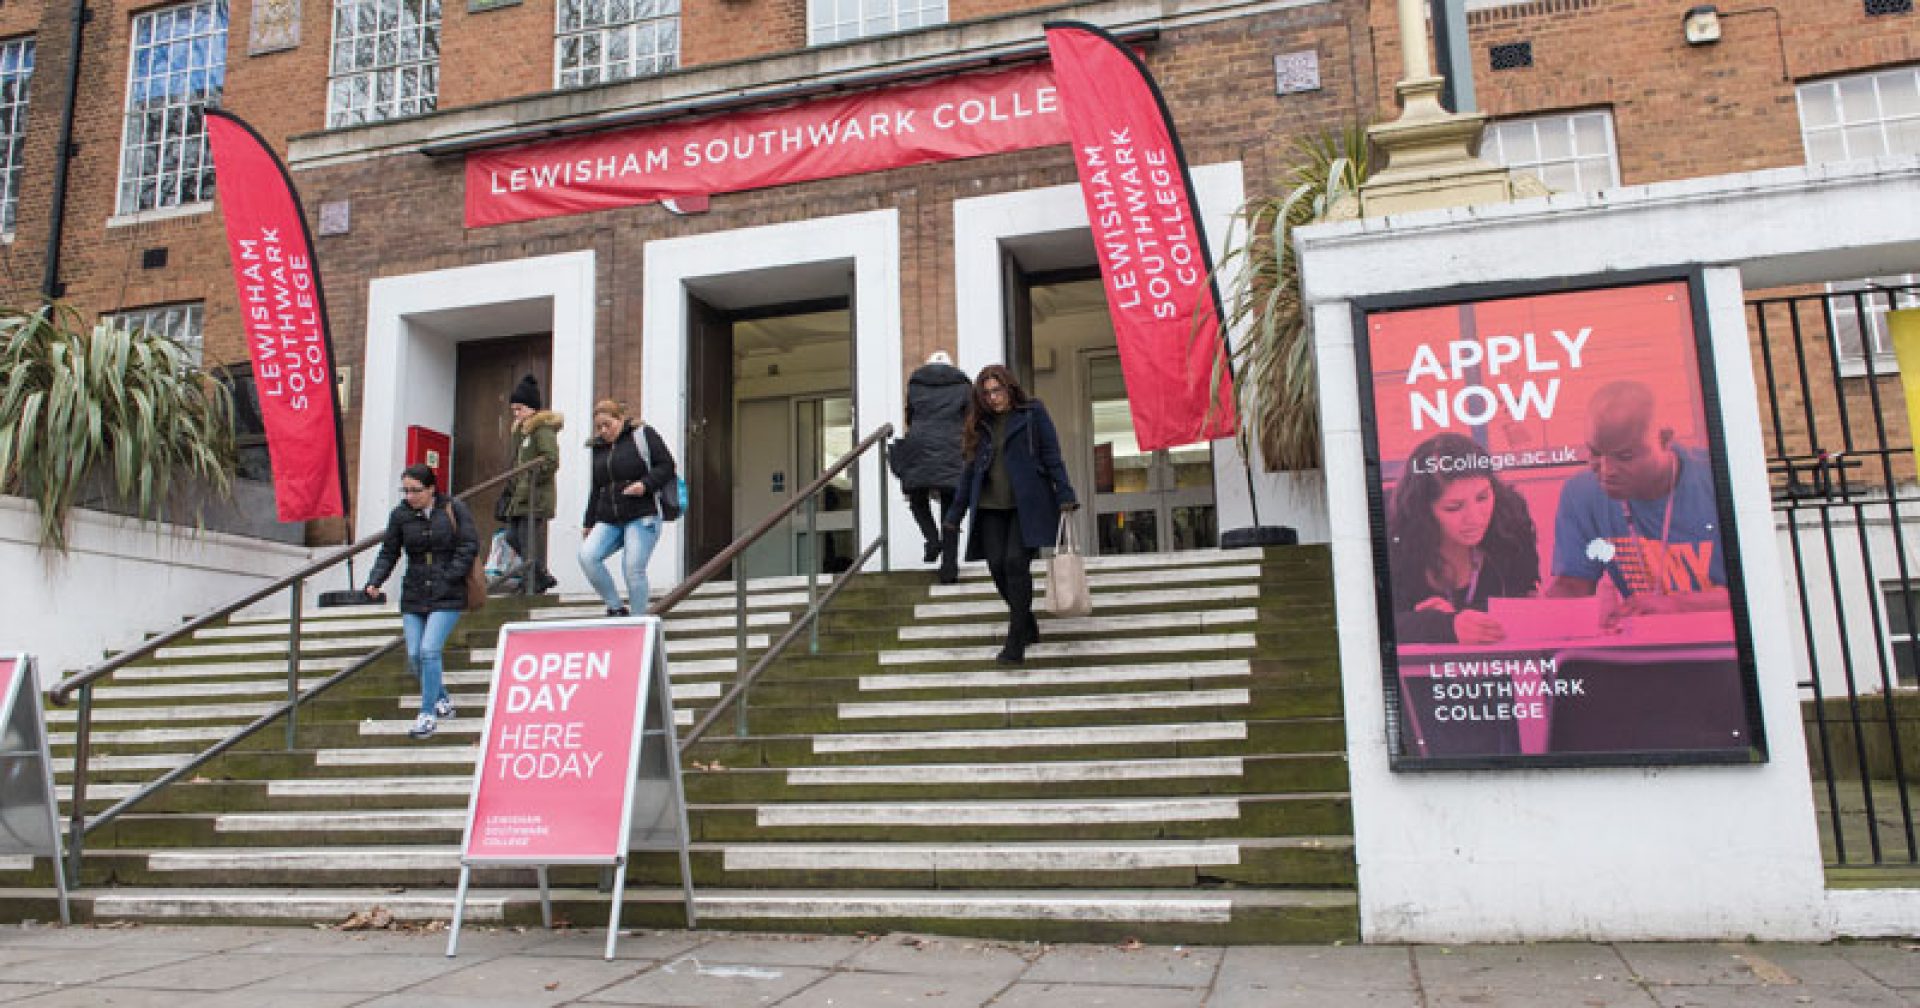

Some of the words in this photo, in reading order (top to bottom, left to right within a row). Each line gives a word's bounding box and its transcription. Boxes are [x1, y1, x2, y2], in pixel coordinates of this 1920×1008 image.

[490, 147, 669, 195] LEWISHAM
[683, 109, 917, 168] SOUTHWARK
[1084, 145, 1142, 309] LEWISHAM
[1109, 126, 1176, 318] SOUTHWARK
[1145, 148, 1198, 285] COLLEGE
[239, 239, 282, 396] LEWISHAM
[261, 227, 308, 411] SOUTHWARK
[288, 253, 325, 384] COLLEGE
[1405, 326, 1593, 384] APPLY
[1409, 378, 1561, 431] NOW
[1412, 445, 1578, 475] LSCollege.ac.uk
[512, 651, 612, 682] OPEN
[1430, 657, 1558, 678] LEWISHAM
[1432, 679, 1585, 700] SOUTHWARK
[506, 683, 580, 714] DAY
[1434, 702, 1544, 722] COLLEGE
[499, 722, 584, 750] HERE
[496, 751, 604, 780] TODAY
